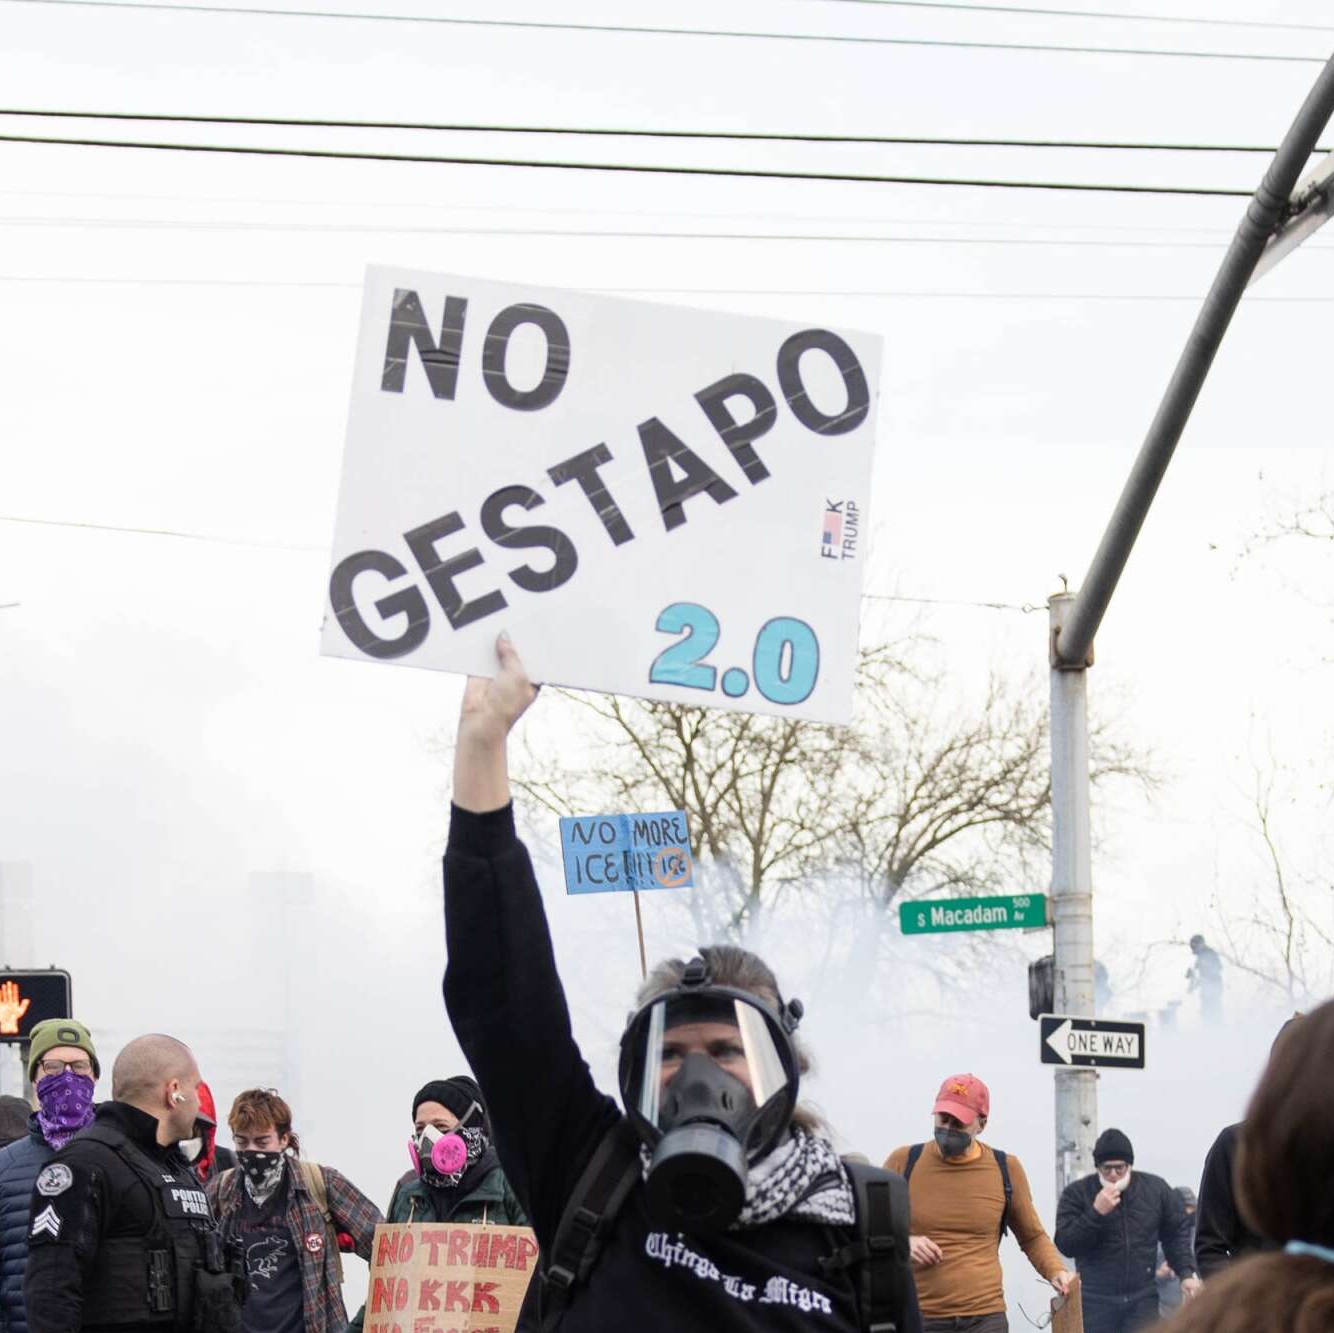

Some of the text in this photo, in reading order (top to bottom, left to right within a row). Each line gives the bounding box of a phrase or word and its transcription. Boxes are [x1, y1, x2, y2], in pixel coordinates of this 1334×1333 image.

[380, 287, 571, 412] NO
[328, 328, 871, 660] GESTAPO
[841, 500, 859, 560] TRUMP
[649, 601, 820, 705] 2.0
[571, 817, 688, 848] NO MORE
[930, 904, 1008, 927] Macadam
[1067, 1033, 1134, 1054] ONE WAY
[376, 1229, 539, 1271] NO TRUMP
[645, 1231, 720, 1281] Chinga
[759, 1275, 832, 1314] Migra
[371, 1277, 502, 1315] NO KKK
